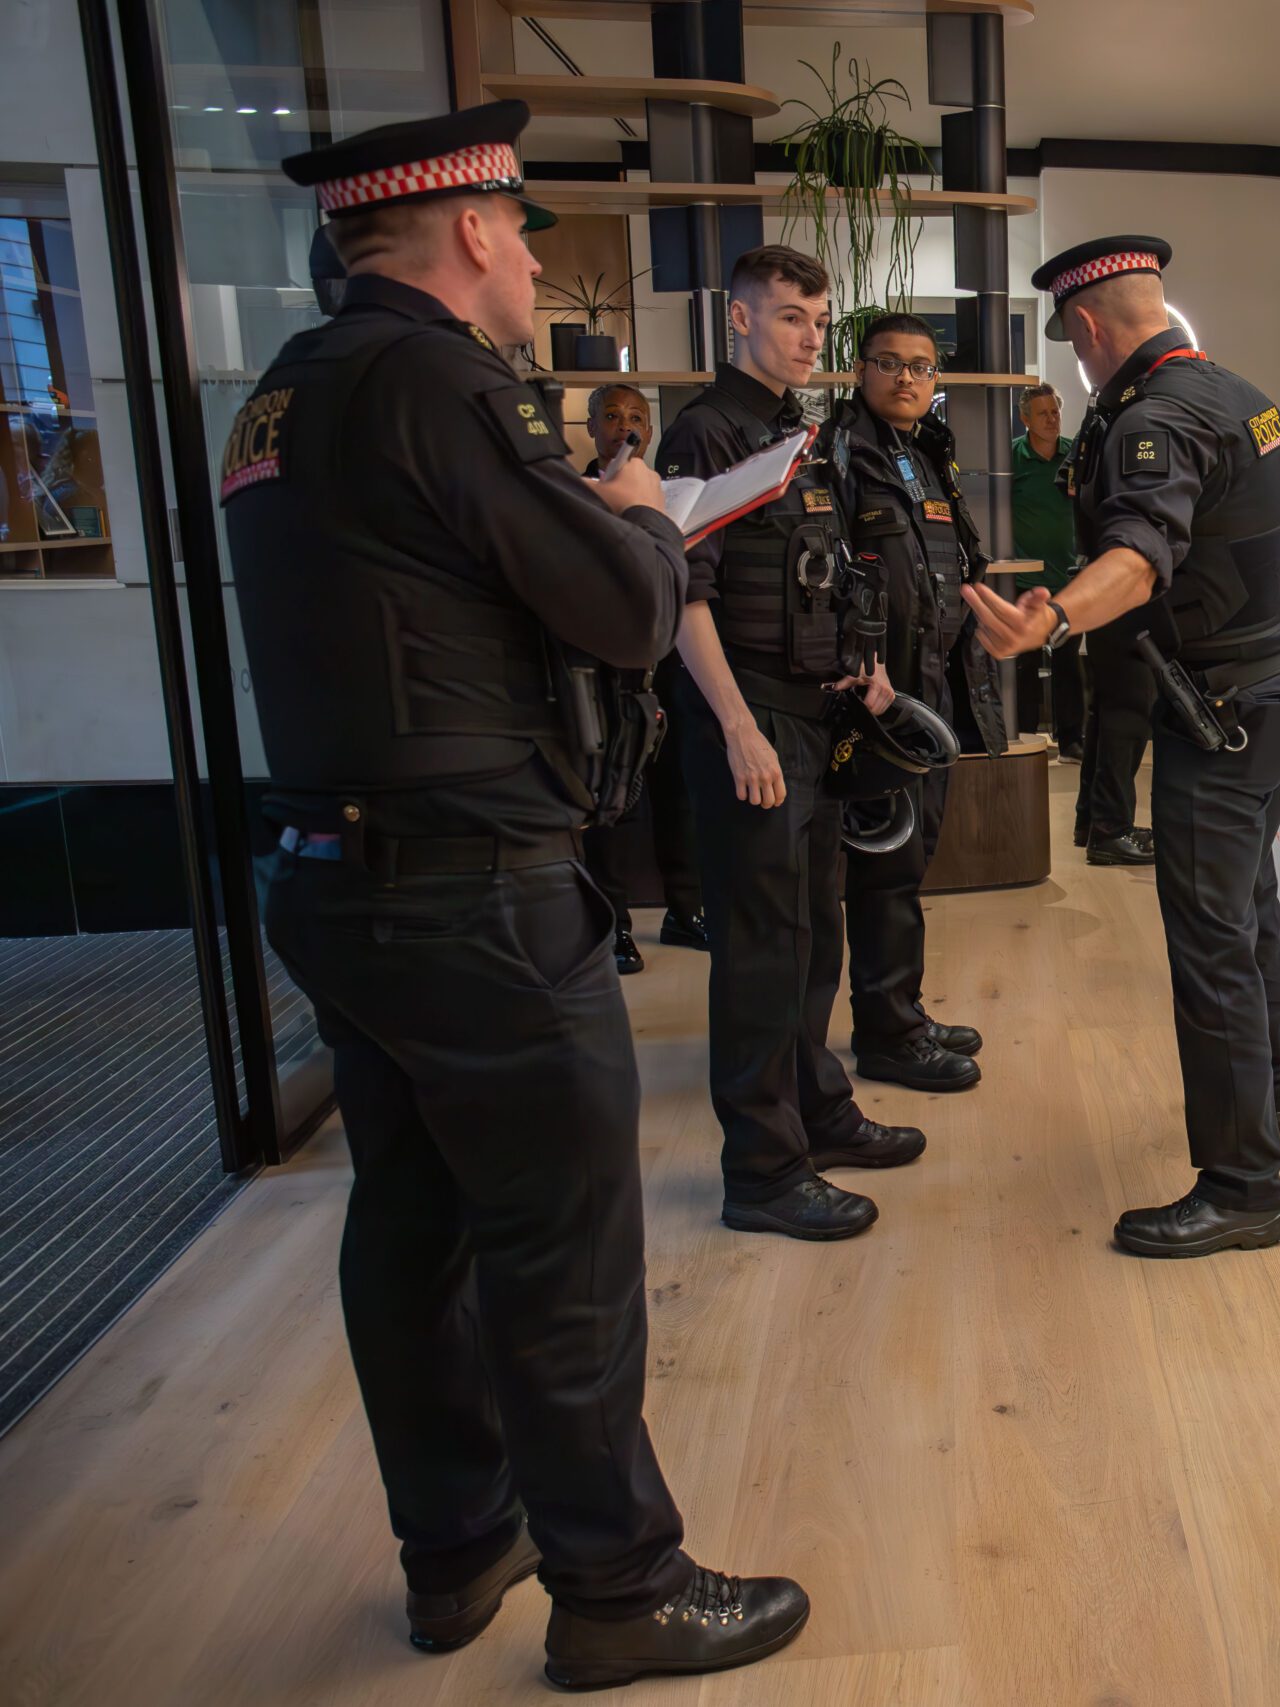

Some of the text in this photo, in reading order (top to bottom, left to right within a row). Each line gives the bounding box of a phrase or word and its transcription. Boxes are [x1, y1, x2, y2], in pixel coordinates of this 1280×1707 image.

[224, 411, 285, 477] OLICE
[1138, 441, 1154, 450] CP
[1136, 451, 1155, 460] 502
[667, 465, 680, 474] CP
